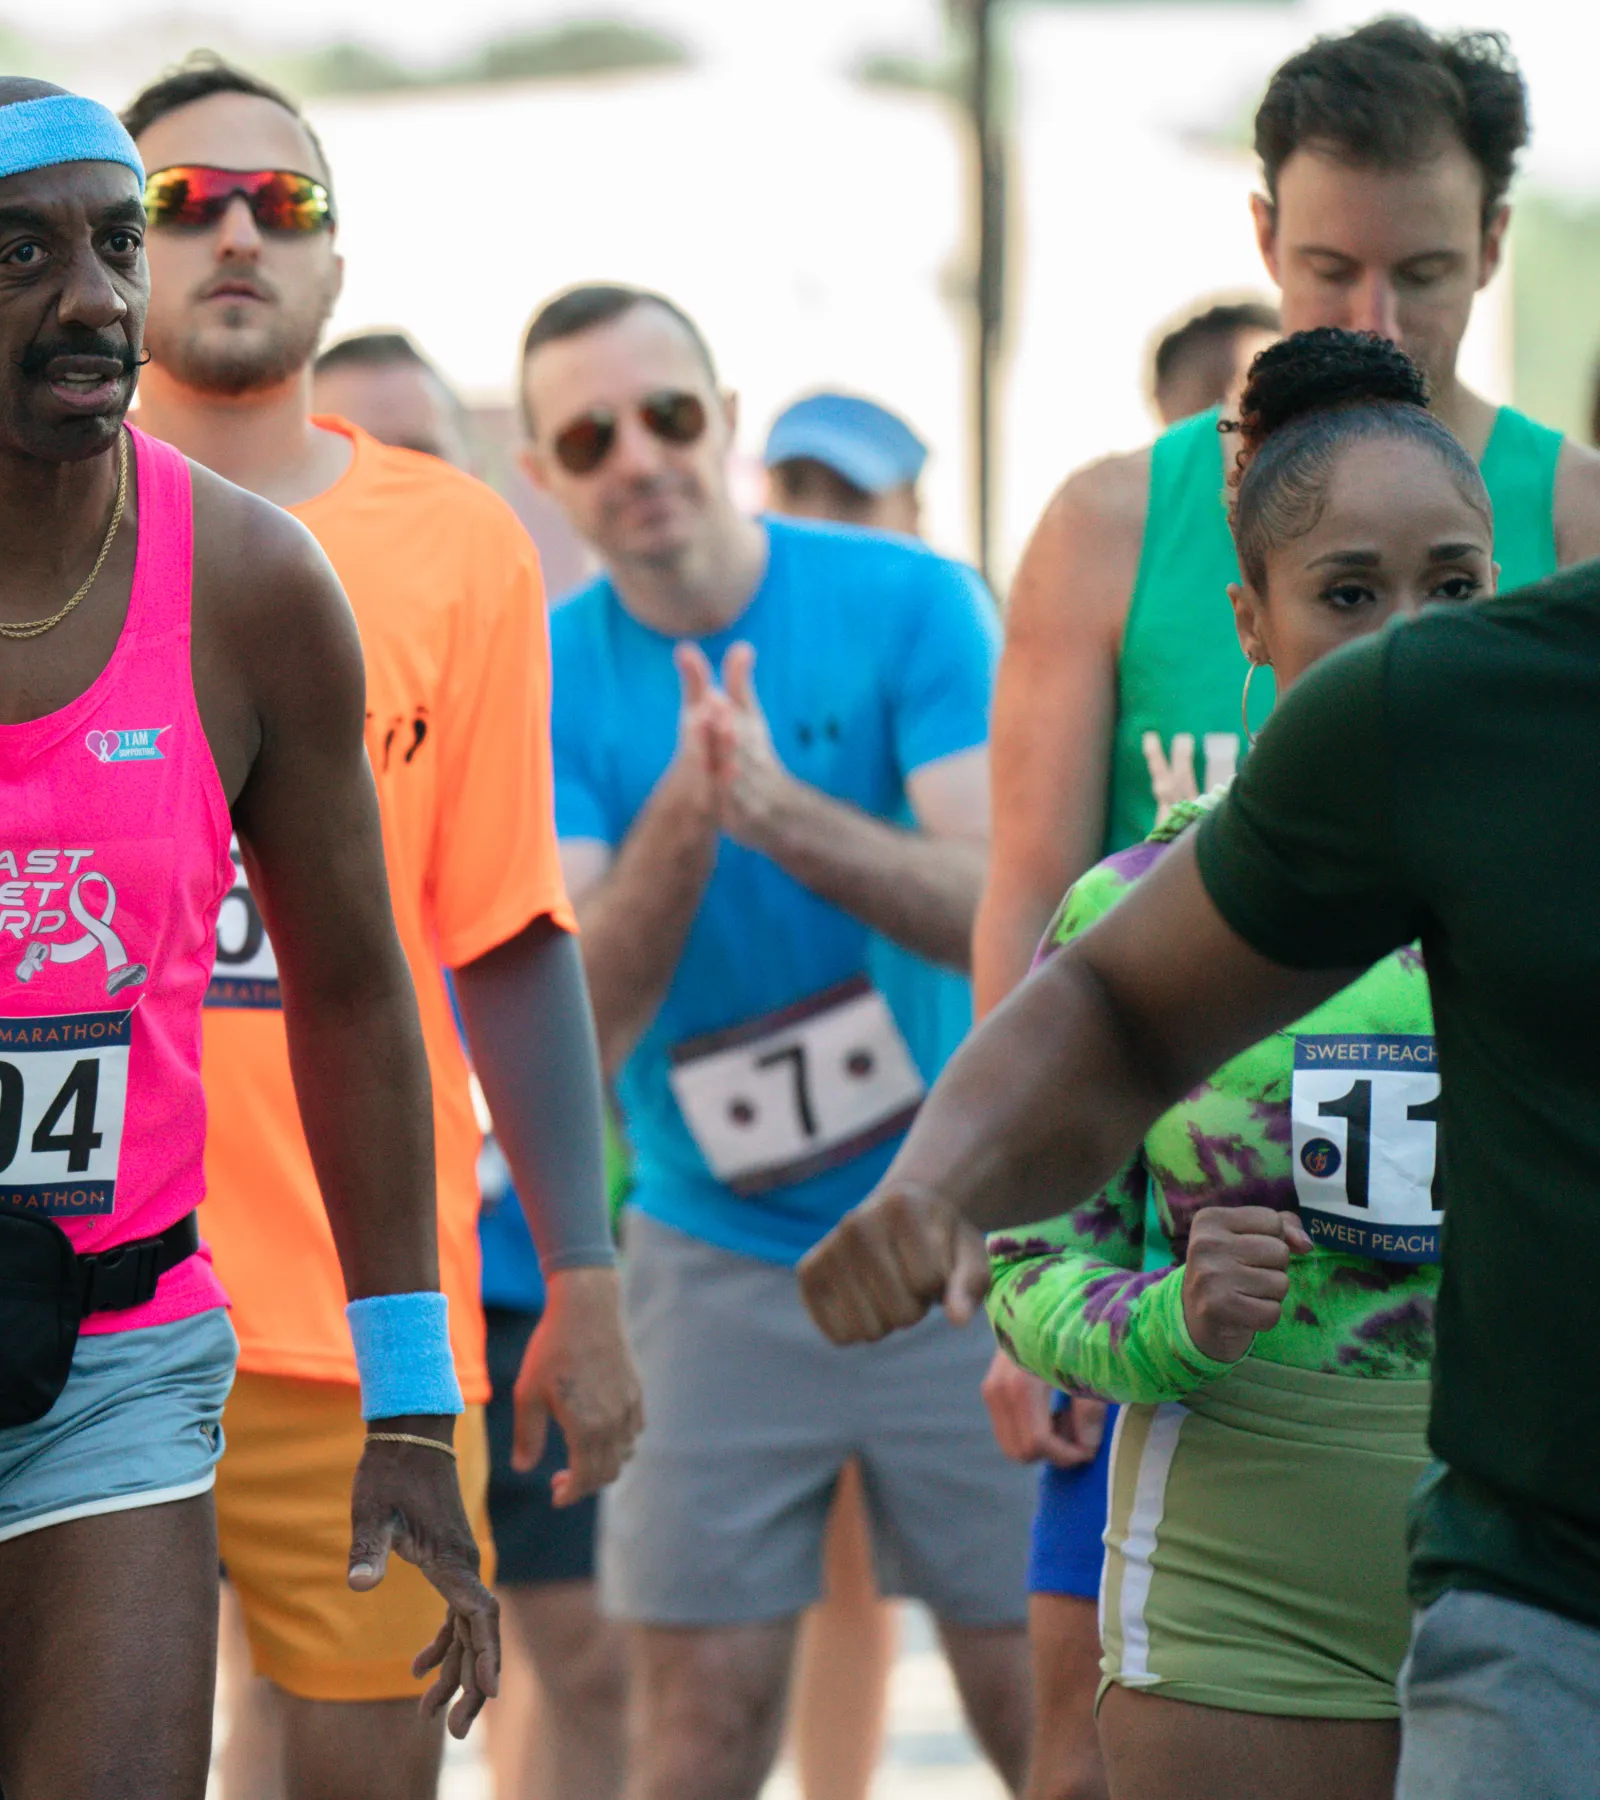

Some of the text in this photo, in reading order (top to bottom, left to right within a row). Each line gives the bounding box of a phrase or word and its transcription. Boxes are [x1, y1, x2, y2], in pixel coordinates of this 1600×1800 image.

[125, 731, 149, 747] I AM
[119, 747, 156, 757] SUPPORTING
[1305, 1043, 1371, 1061] SWEET
[754, 1042, 820, 1136] 7
[1311, 1218, 1435, 1253] SWEET PEACH
